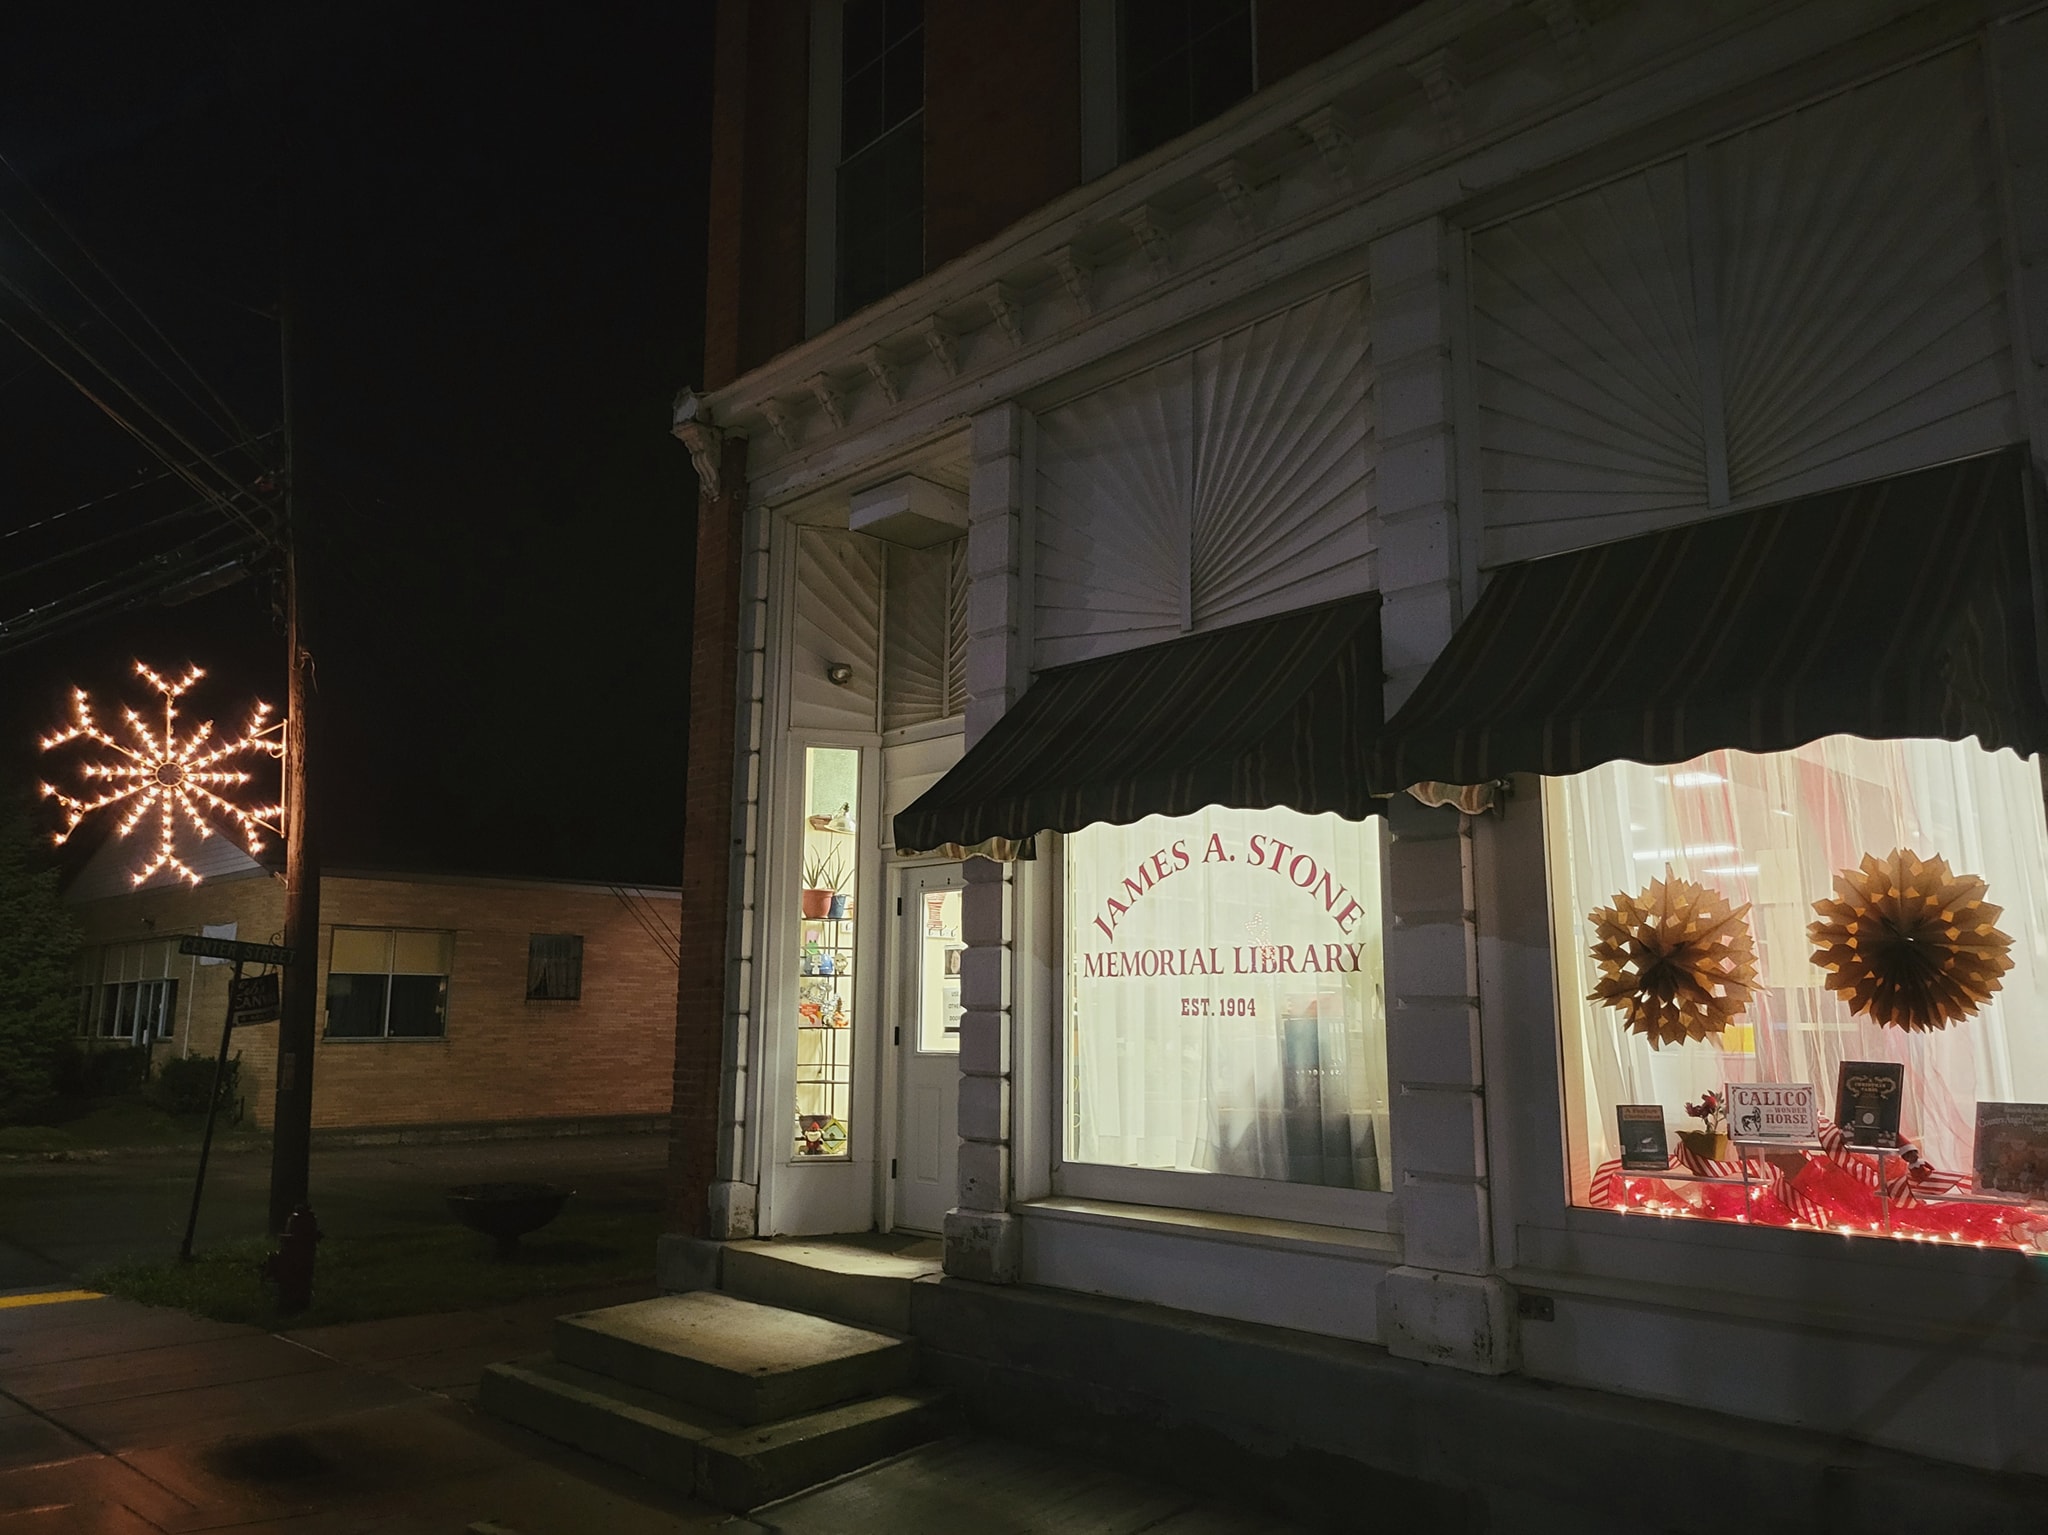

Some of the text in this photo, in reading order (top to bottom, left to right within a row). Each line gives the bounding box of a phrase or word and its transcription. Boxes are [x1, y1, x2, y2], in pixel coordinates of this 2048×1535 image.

[1092, 833, 1366, 944] JAMES A. STONE
[182, 936, 296, 964] CENTER STREET
[1083, 942, 1367, 978] MEMORIAL LIBRARY
[1181, 997, 1256, 1017] EST. 1904
[1737, 1090, 1808, 1106] CALICO
[1765, 1113, 1808, 1124] HORSE
